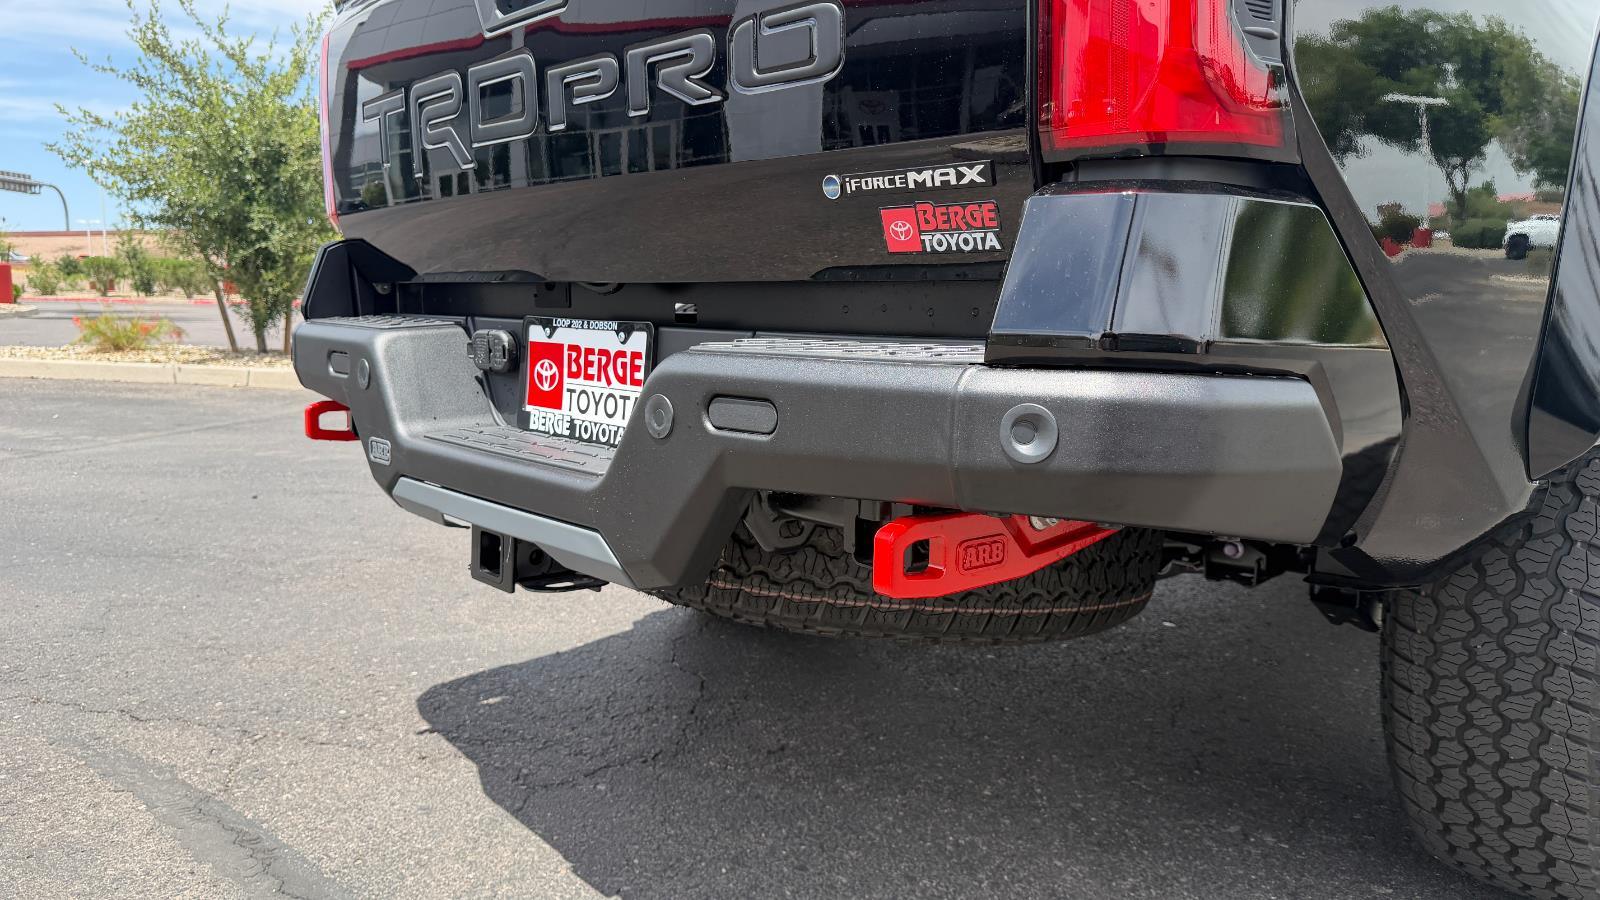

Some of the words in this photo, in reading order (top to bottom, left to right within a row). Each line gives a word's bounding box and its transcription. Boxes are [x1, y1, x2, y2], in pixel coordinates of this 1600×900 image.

[916, 203, 998, 231] BERGE
[921, 232, 1002, 252] TOYOTA
[553, 318, 570, 328] LOOP
[571, 319, 582, 329] 202
[583, 320, 589, 329] &
[590, 321, 618, 331] DOBSON
[566, 344, 644, 387] BERGE
[566, 388, 639, 420] TOYOT
[529, 409, 571, 436] BERGE
[963, 540, 1005, 570] ARB
